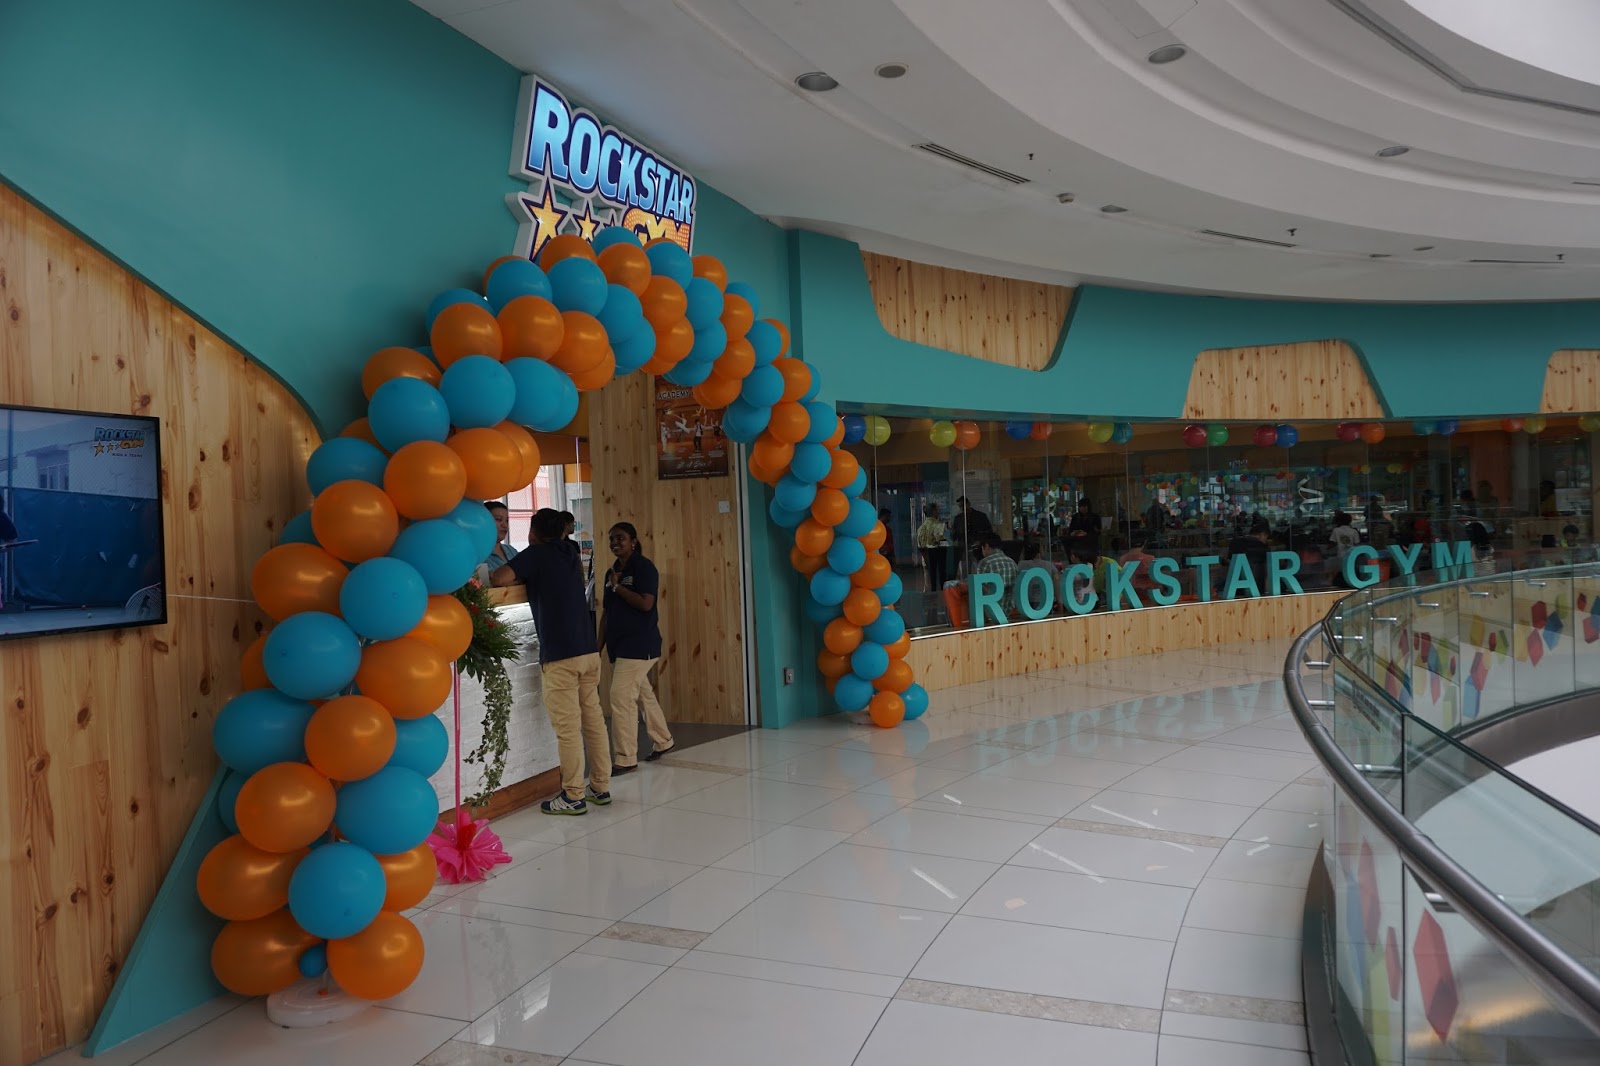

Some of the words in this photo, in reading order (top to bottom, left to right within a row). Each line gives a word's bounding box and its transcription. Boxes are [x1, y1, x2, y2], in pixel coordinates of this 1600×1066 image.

[525, 81, 693, 224] ROCKSTAR
[657, 390, 689, 400] ACADEMY
[94, 427, 146, 441] ROCKSTAR
[120, 439, 145, 449] GYM
[968, 550, 1304, 628] ROCKSTAR
[1344, 540, 1475, 589] GYM
